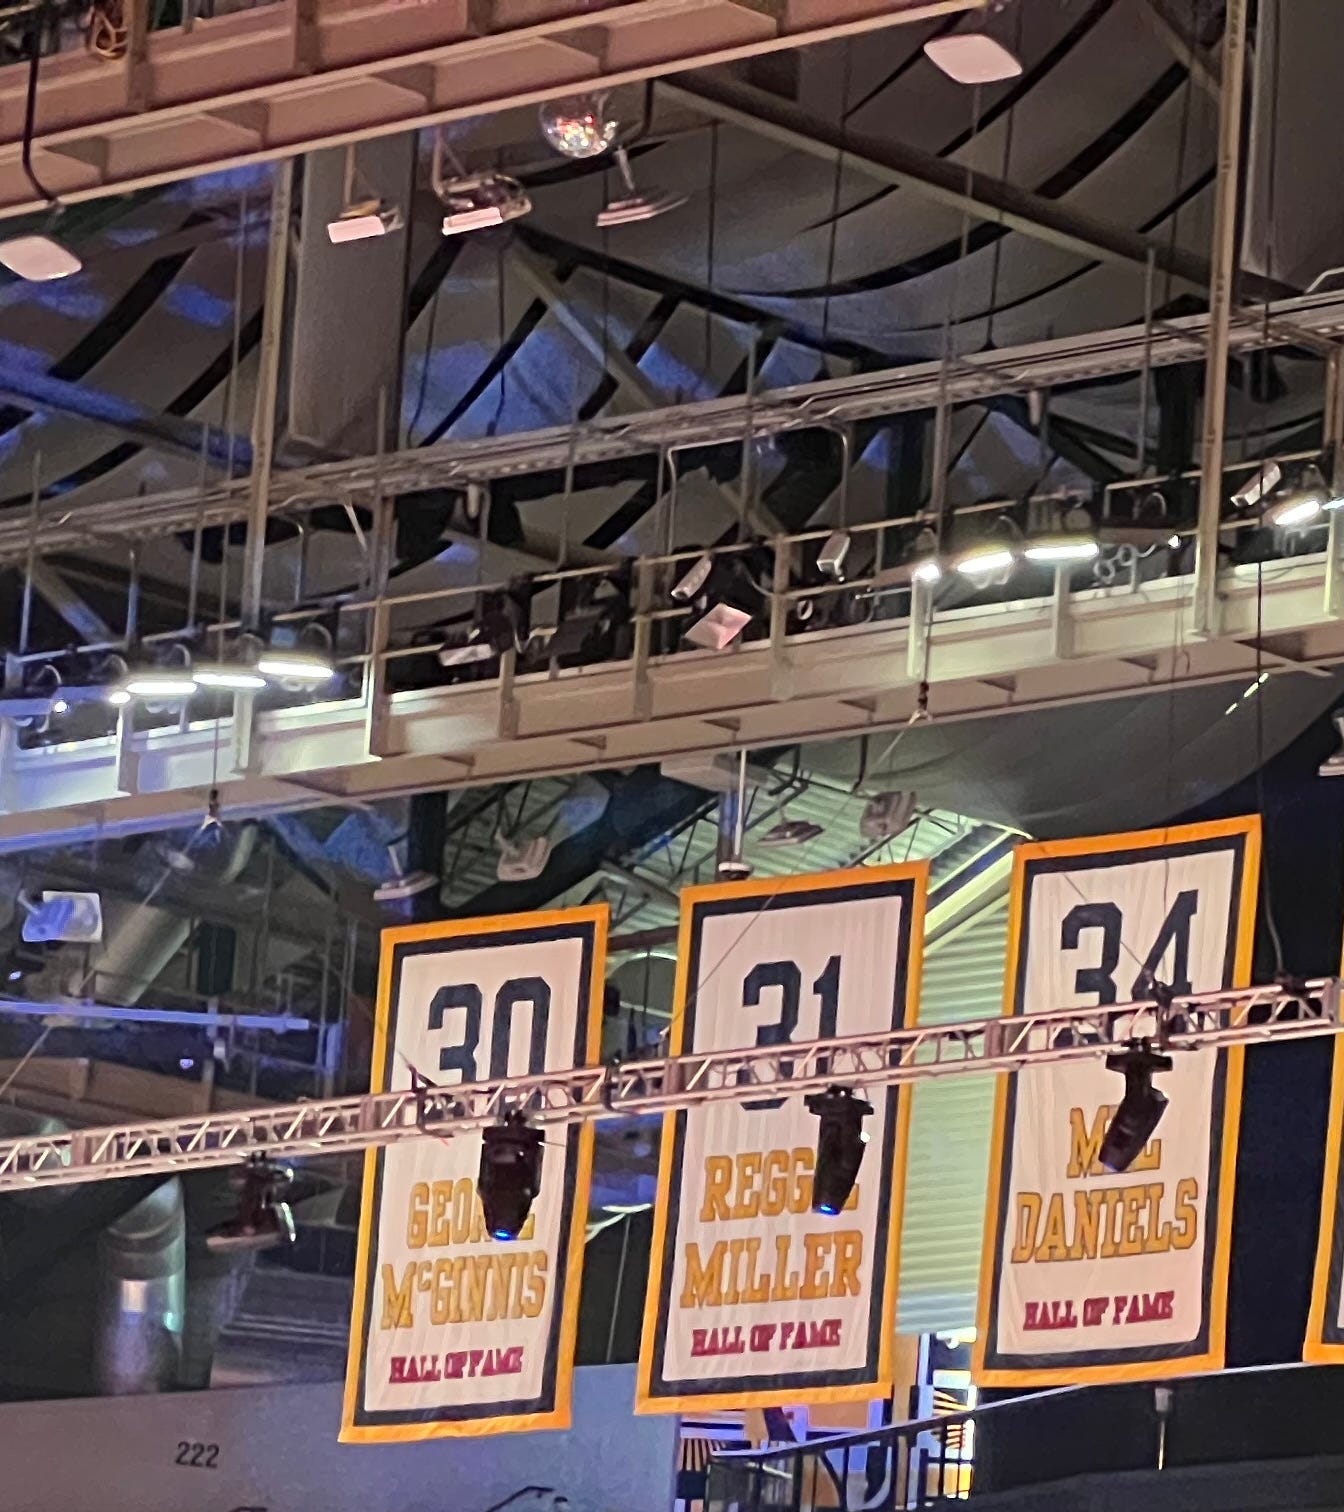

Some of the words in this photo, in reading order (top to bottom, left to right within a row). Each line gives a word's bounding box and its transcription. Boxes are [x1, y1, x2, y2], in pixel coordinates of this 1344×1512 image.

[1054, 890, 1199, 1049] 34
[428, 976, 551, 1118] 30
[738, 955, 842, 1111] 31
[407, 1178, 535, 1249] GEO
[700, 1147, 859, 1222] REGG
[1011, 1178, 1198, 1264] DANIELS
[680, 1230, 863, 1309] MILLER
[691, 1326, 745, 1357] HALL
[750, 1324, 777, 1352] OF
[780, 1319, 842, 1350] FAME
[1023, 1301, 1077, 1330] HALL
[1083, 1297, 1109, 1326] OF
[1113, 1291, 1174, 1324] FAME
[389, 1355, 441, 1384] HALL
[444, 1351, 468, 1379] OF
[468, 1346, 524, 1377] FAME
[175, 1441, 220, 1469] 222
